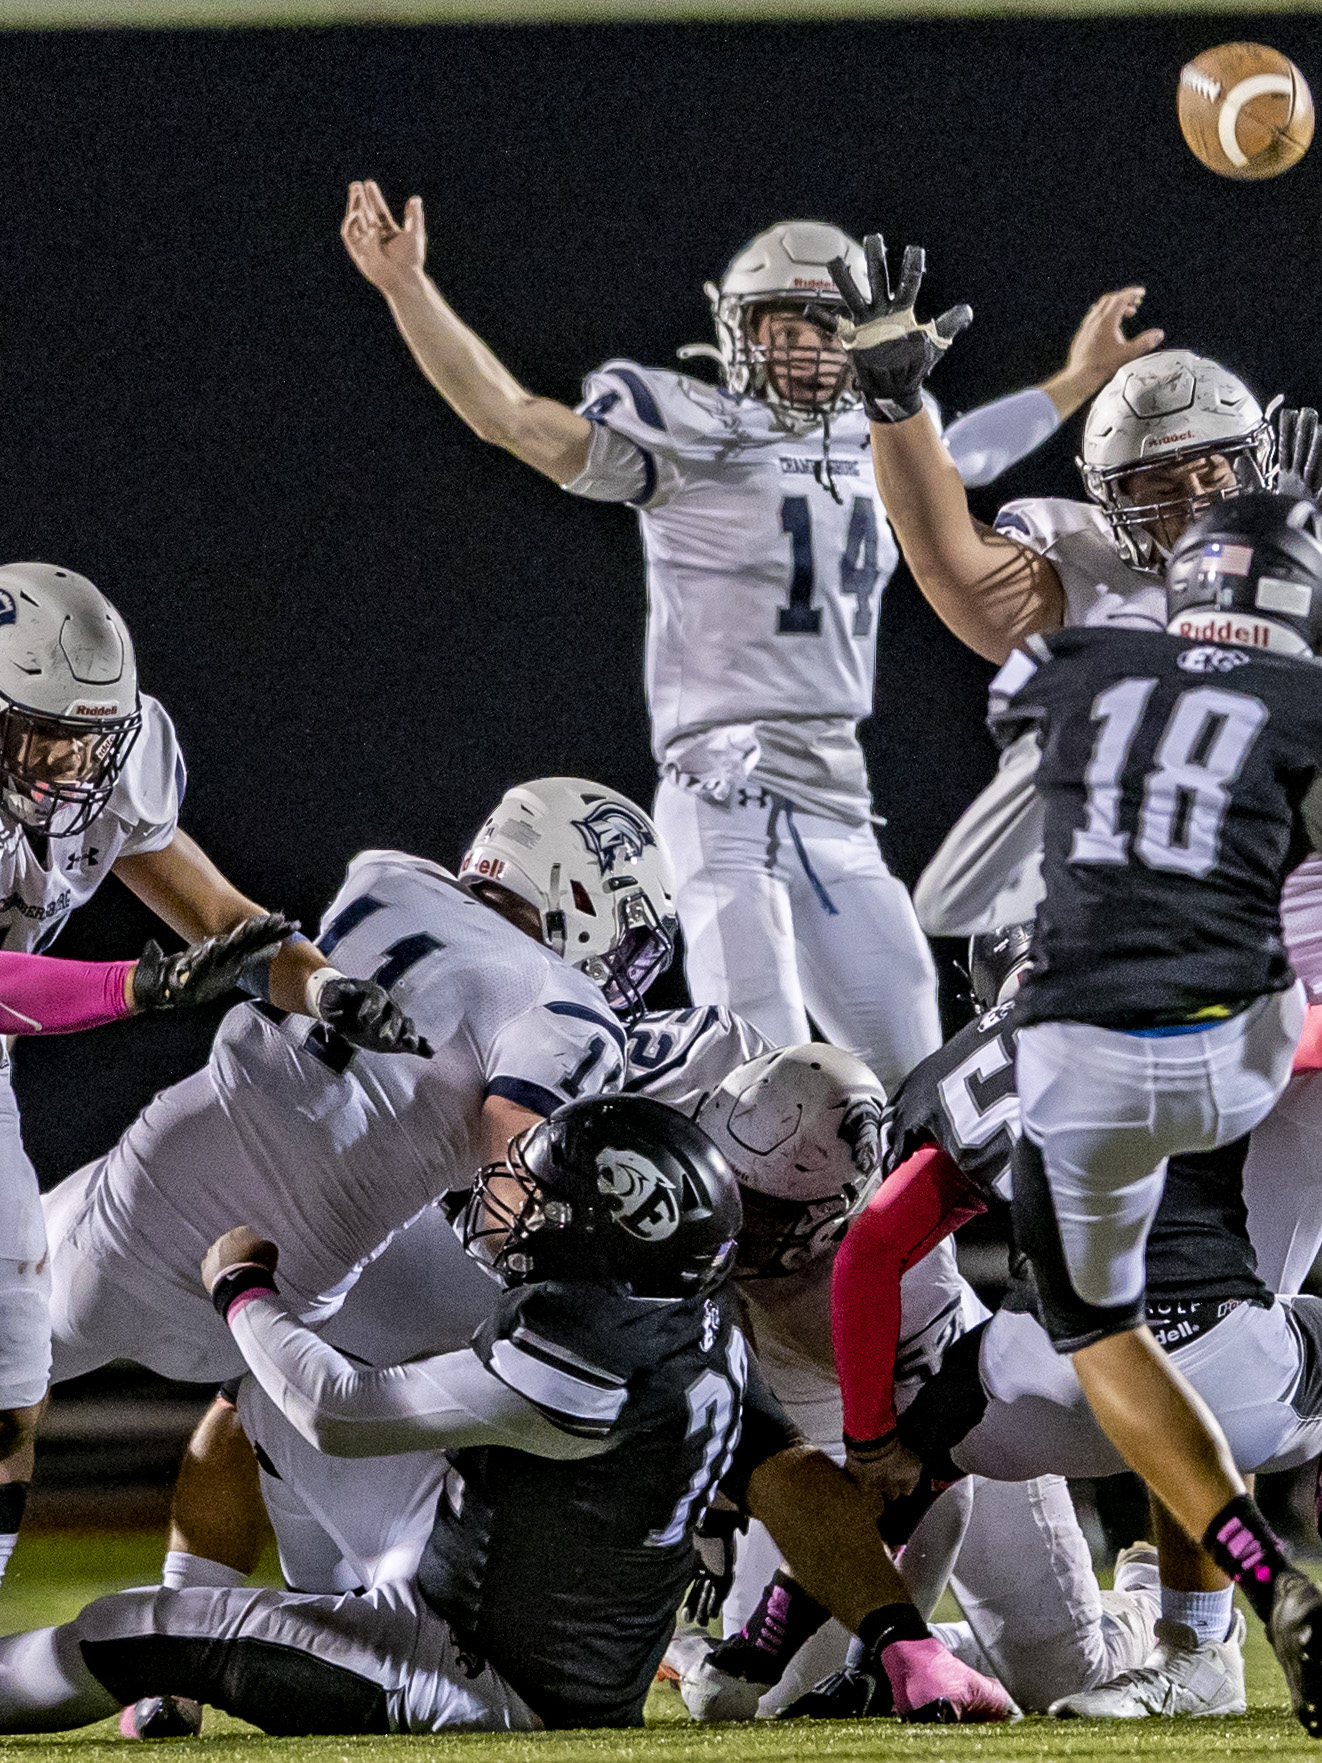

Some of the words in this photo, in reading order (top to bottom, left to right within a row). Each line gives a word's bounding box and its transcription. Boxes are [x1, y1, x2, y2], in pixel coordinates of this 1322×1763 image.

[794, 277, 836, 289] Ridde
[776, 493, 878, 638] 14
[1180, 620, 1269, 647] Riddell
[76, 704, 118, 717] Riddell
[1066, 676, 1271, 879] 18
